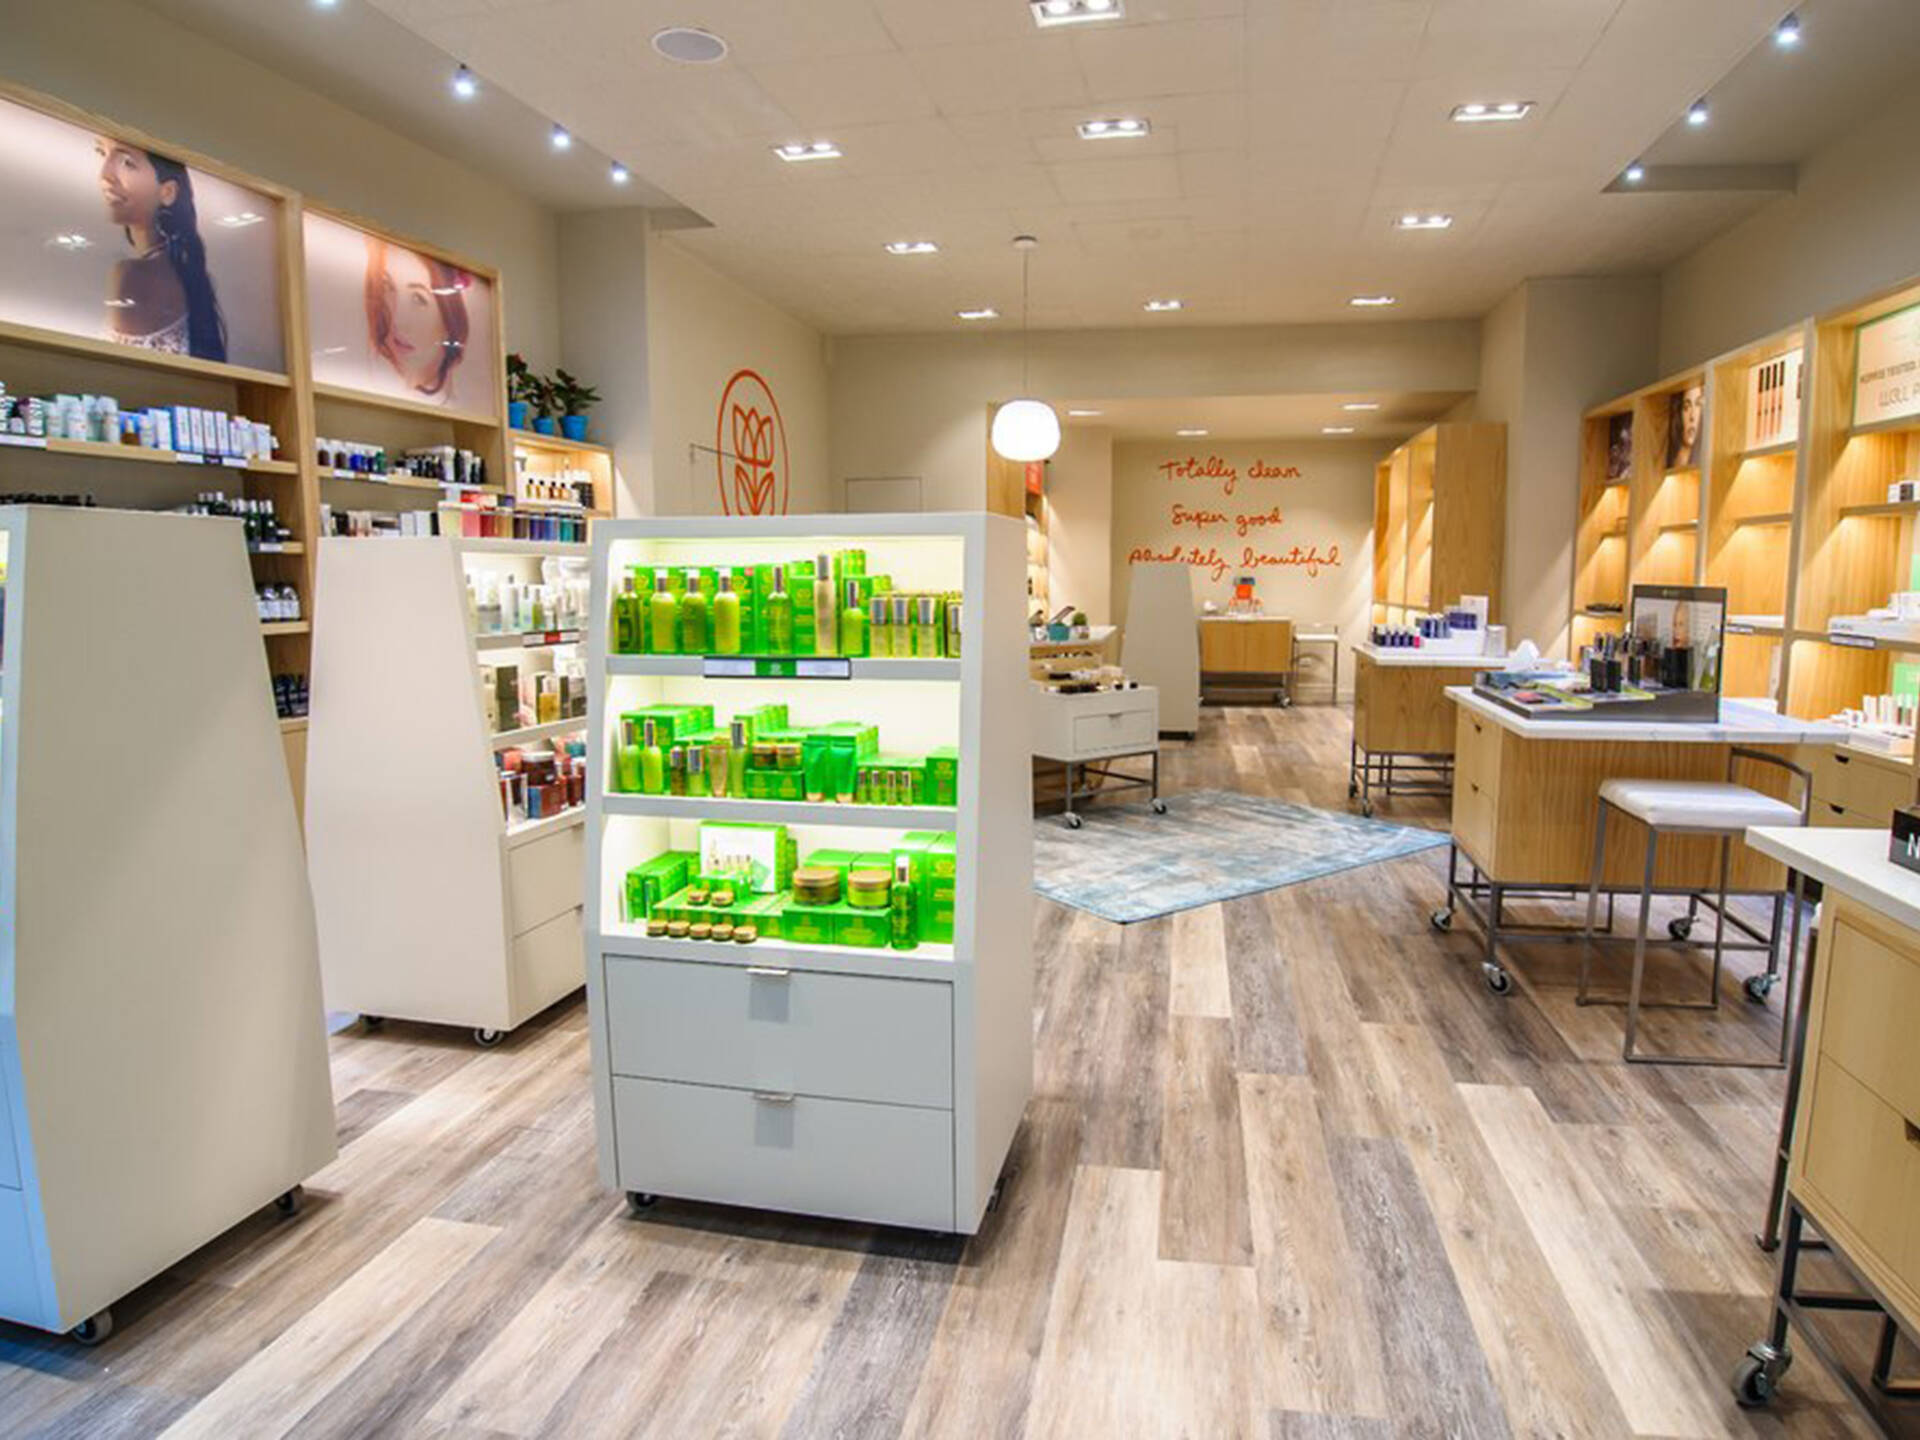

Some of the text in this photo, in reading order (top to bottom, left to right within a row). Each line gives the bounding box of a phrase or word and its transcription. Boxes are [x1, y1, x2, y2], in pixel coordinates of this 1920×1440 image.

[1159, 457, 1301, 495] Totally clean
[1172, 504, 1283, 537] Super good
[1241, 547, 1341, 577] beautiful
